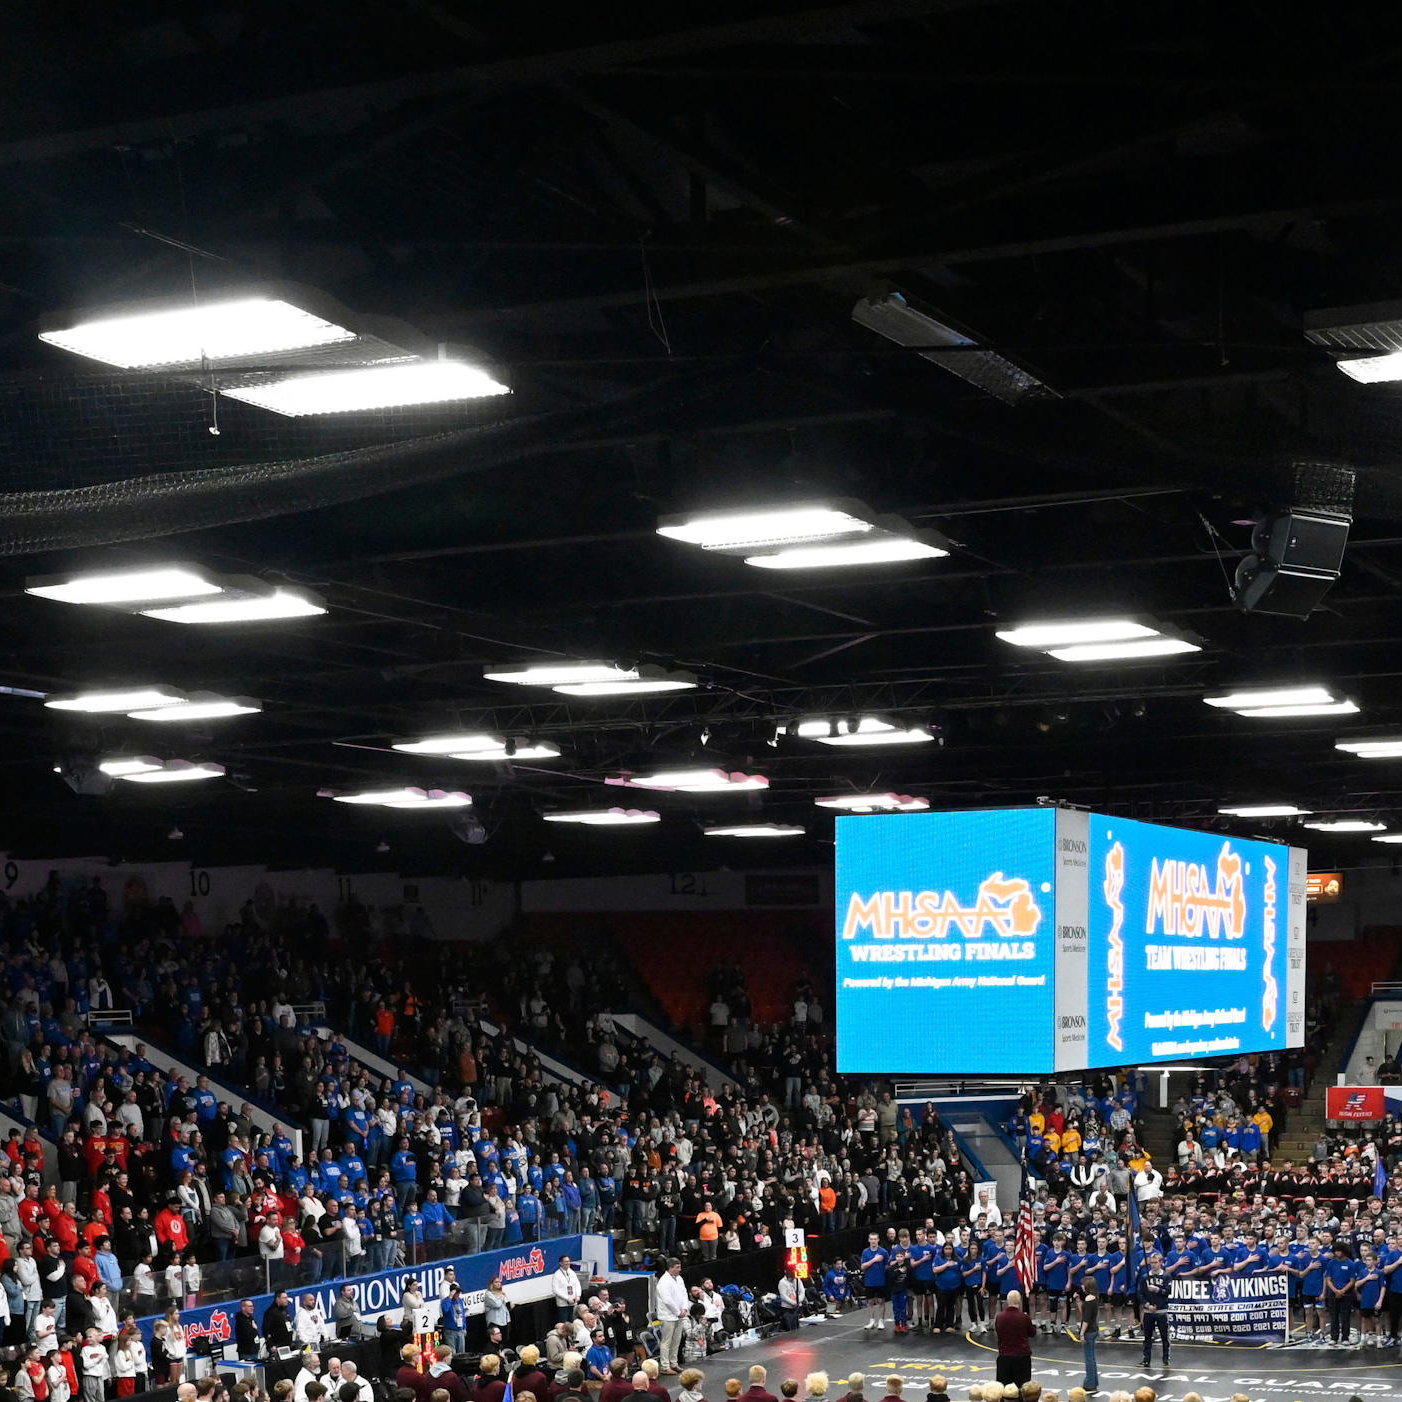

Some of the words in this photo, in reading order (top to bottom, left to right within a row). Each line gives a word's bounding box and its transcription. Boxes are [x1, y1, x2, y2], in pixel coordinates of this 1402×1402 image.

[1062, 838, 1086, 853] BRONSON
[4, 862, 18, 888] 9
[190, 870, 210, 897] 10
[1146, 852, 1242, 939] MHSAA
[842, 884, 1023, 939] MHSAA
[1062, 926, 1086, 939] BRONSON
[850, 943, 961, 961] WRESTLING
[964, 942, 1035, 960] FINALS
[1145, 945, 1173, 970] TEAM
[1173, 946, 1219, 970] WRESTLING
[1220, 947, 1246, 971] FINALS
[952, 977, 977, 988] Army
[1062, 1016, 1086, 1029] BRONSON
[792, 1233, 798, 1244] 3
[499, 1252, 540, 1281] MHSAA
[1231, 1275, 1287, 1298] VIKINGS
[1194, 1314, 1209, 1322] 1997
[1212, 1314, 1228, 1322] 1998
[1230, 1312, 1247, 1321] 2001
[1249, 1311, 1268, 1320] 2007
[1270, 1309, 1286, 1318] 2013
[1207, 1303, 1234, 1311] STATE
[422, 1315, 428, 1328] 2
[1253, 1322, 1270, 1330] 2021
[869, 1362, 996, 1372] ARMY
[1233, 1378, 1393, 1391] GUARD
